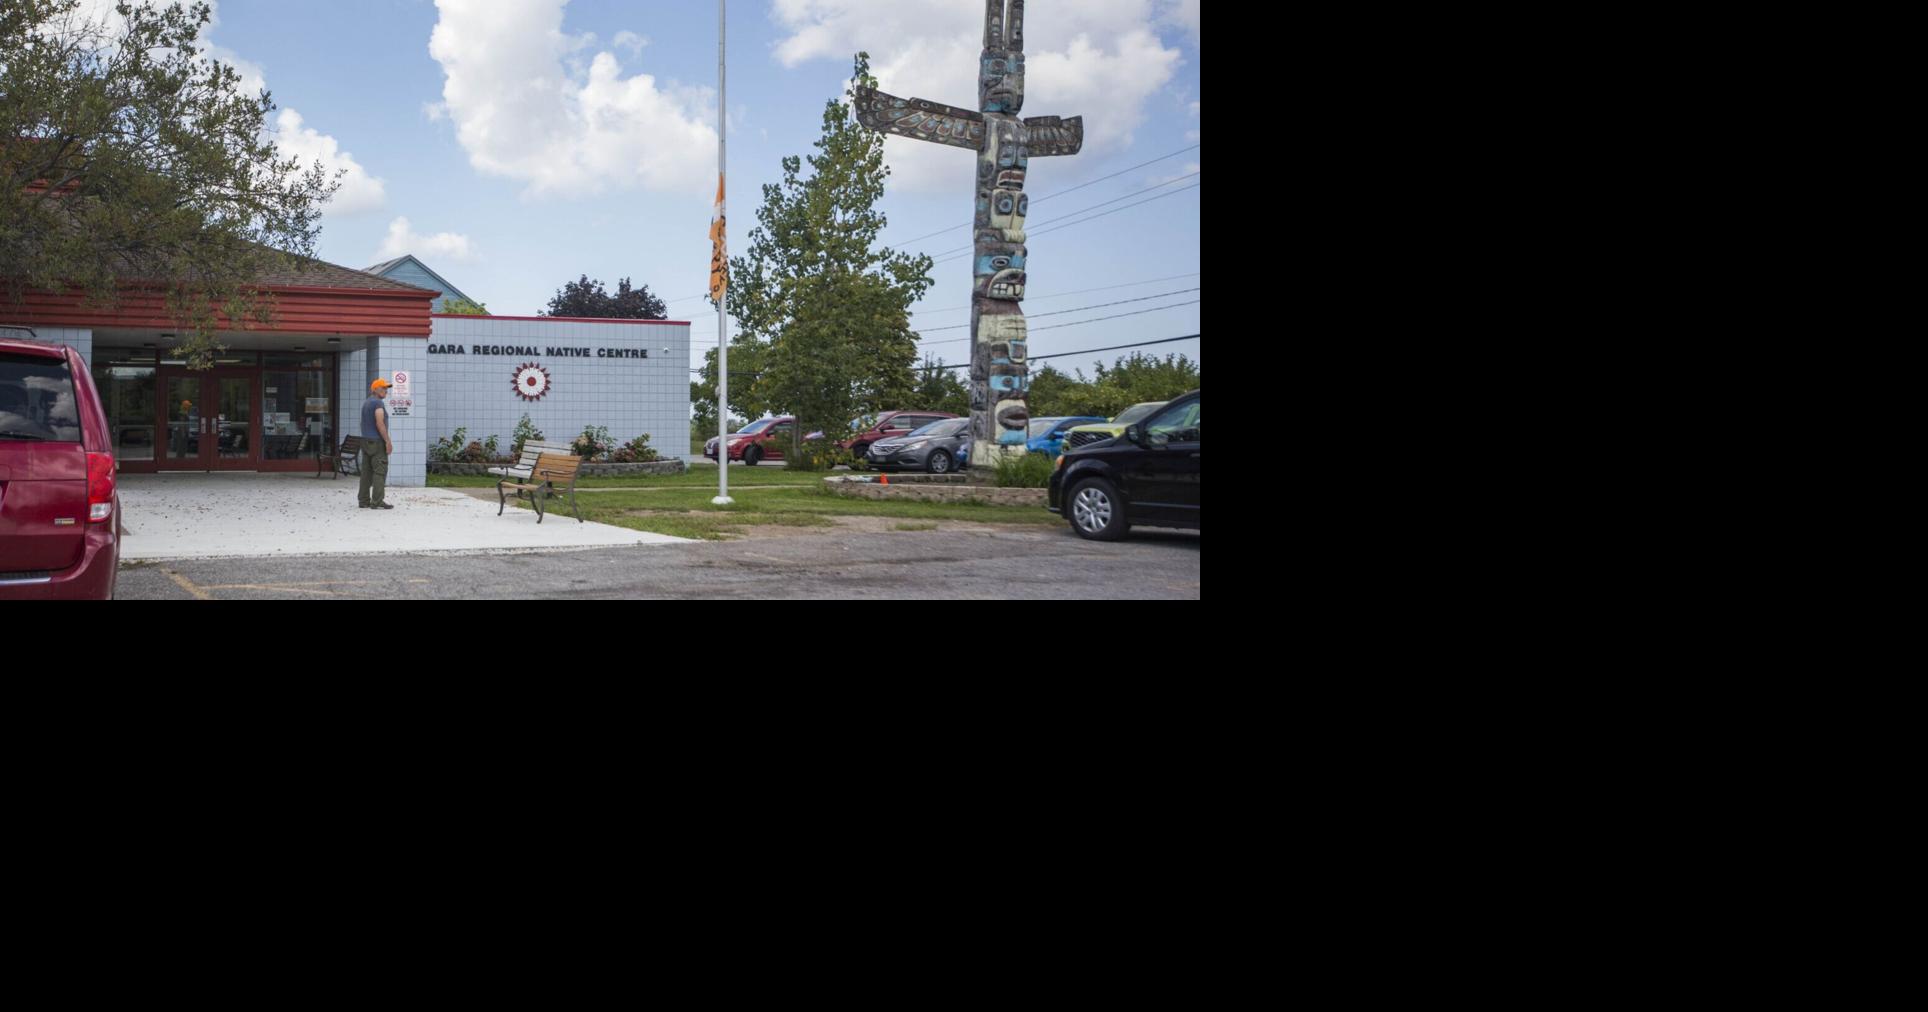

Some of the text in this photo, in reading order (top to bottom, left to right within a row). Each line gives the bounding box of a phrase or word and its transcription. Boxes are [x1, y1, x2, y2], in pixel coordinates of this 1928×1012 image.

[427, 344, 647, 358] GARA REGIONAL NATIVE CENTRE
